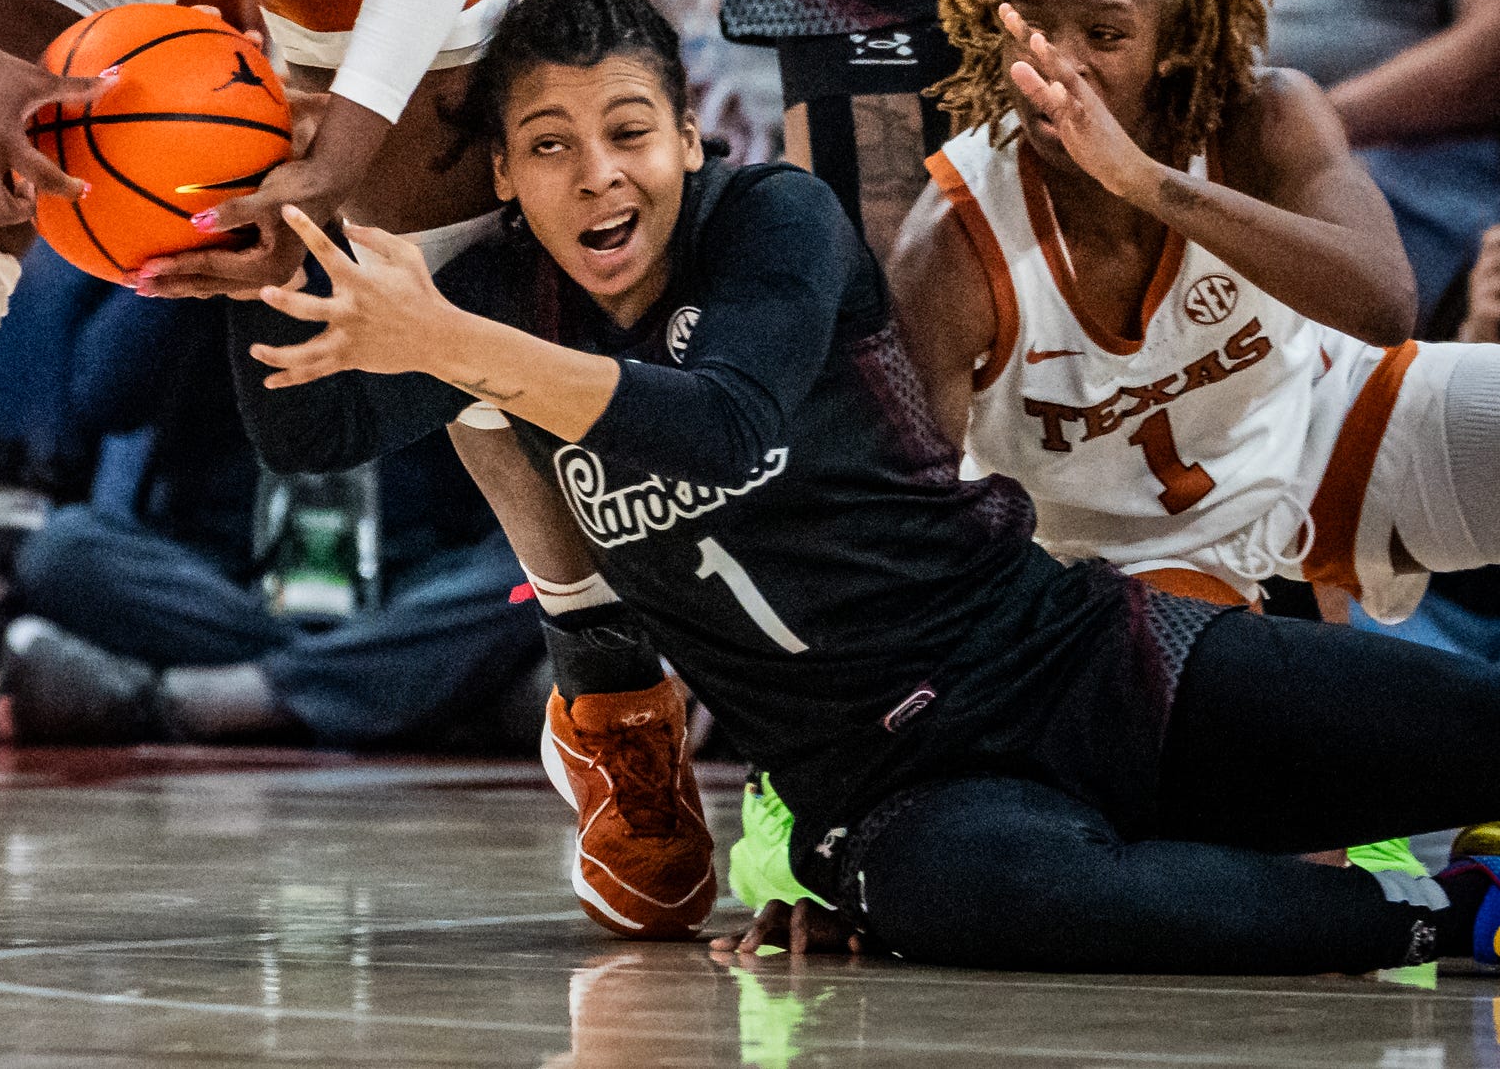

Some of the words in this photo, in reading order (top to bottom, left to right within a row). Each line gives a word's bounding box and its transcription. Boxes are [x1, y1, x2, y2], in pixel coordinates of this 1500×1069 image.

[1185, 274, 1238, 325] SEC
[1023, 316, 1274, 453] TEXAS
[1127, 408, 1217, 516] 1
[695, 536, 810, 654] 1
